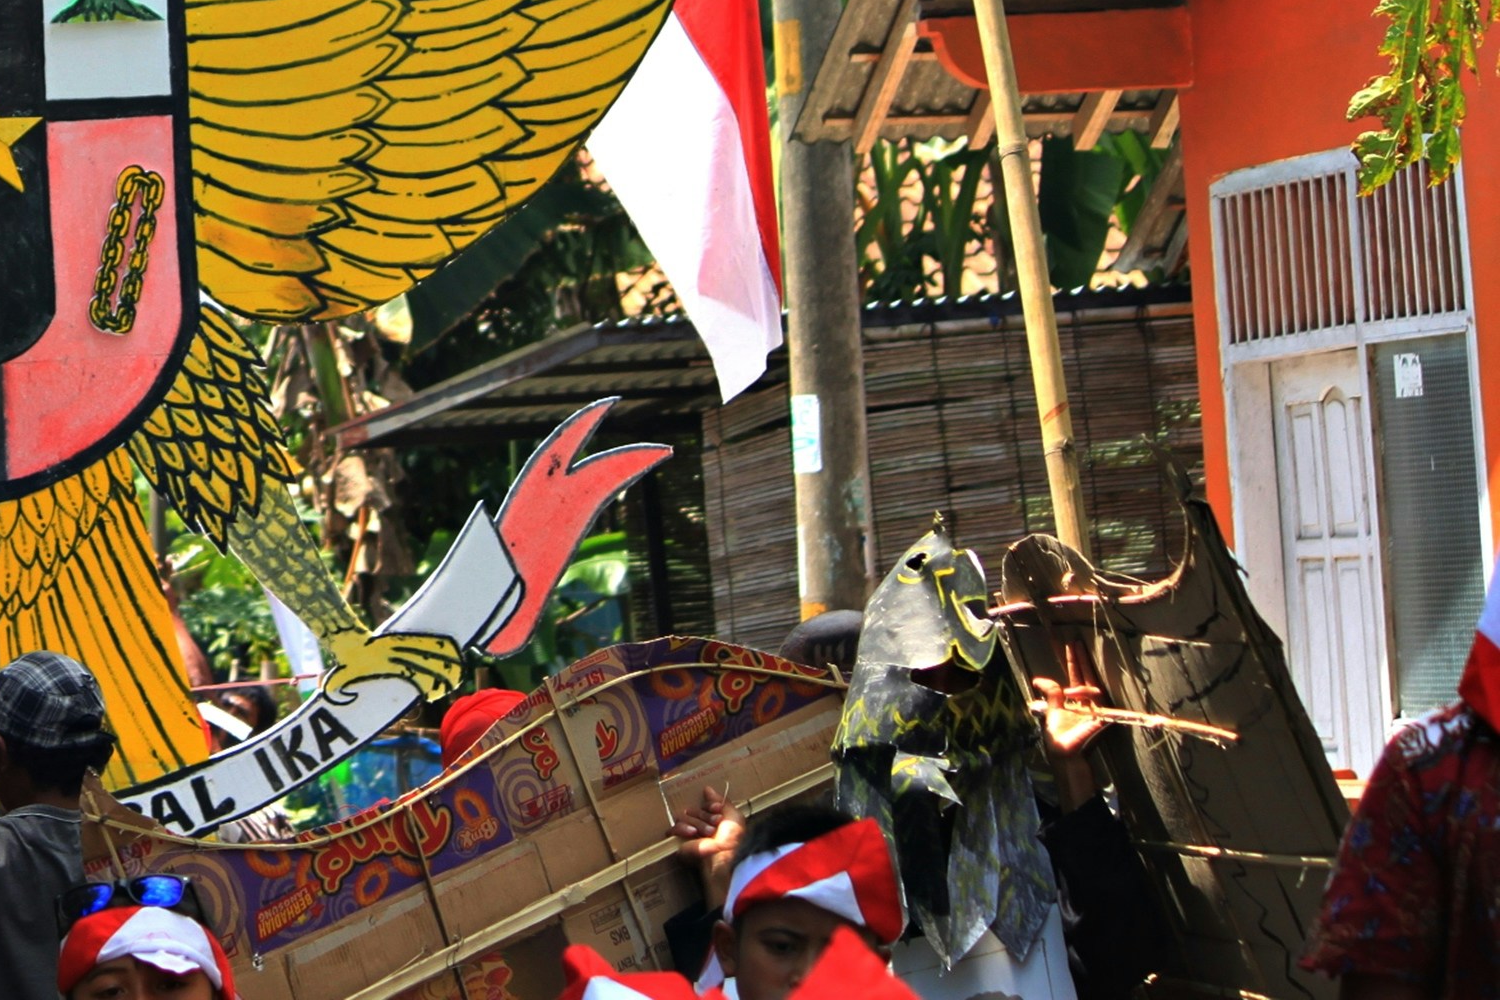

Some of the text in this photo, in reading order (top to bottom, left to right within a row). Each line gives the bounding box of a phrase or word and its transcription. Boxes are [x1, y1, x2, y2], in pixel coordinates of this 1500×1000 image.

[123, 706, 358, 832] AL IKA
[257, 892, 314, 939] BERHADIAH
[609, 925, 631, 946] BKS
[617, 953, 636, 972] TENT
